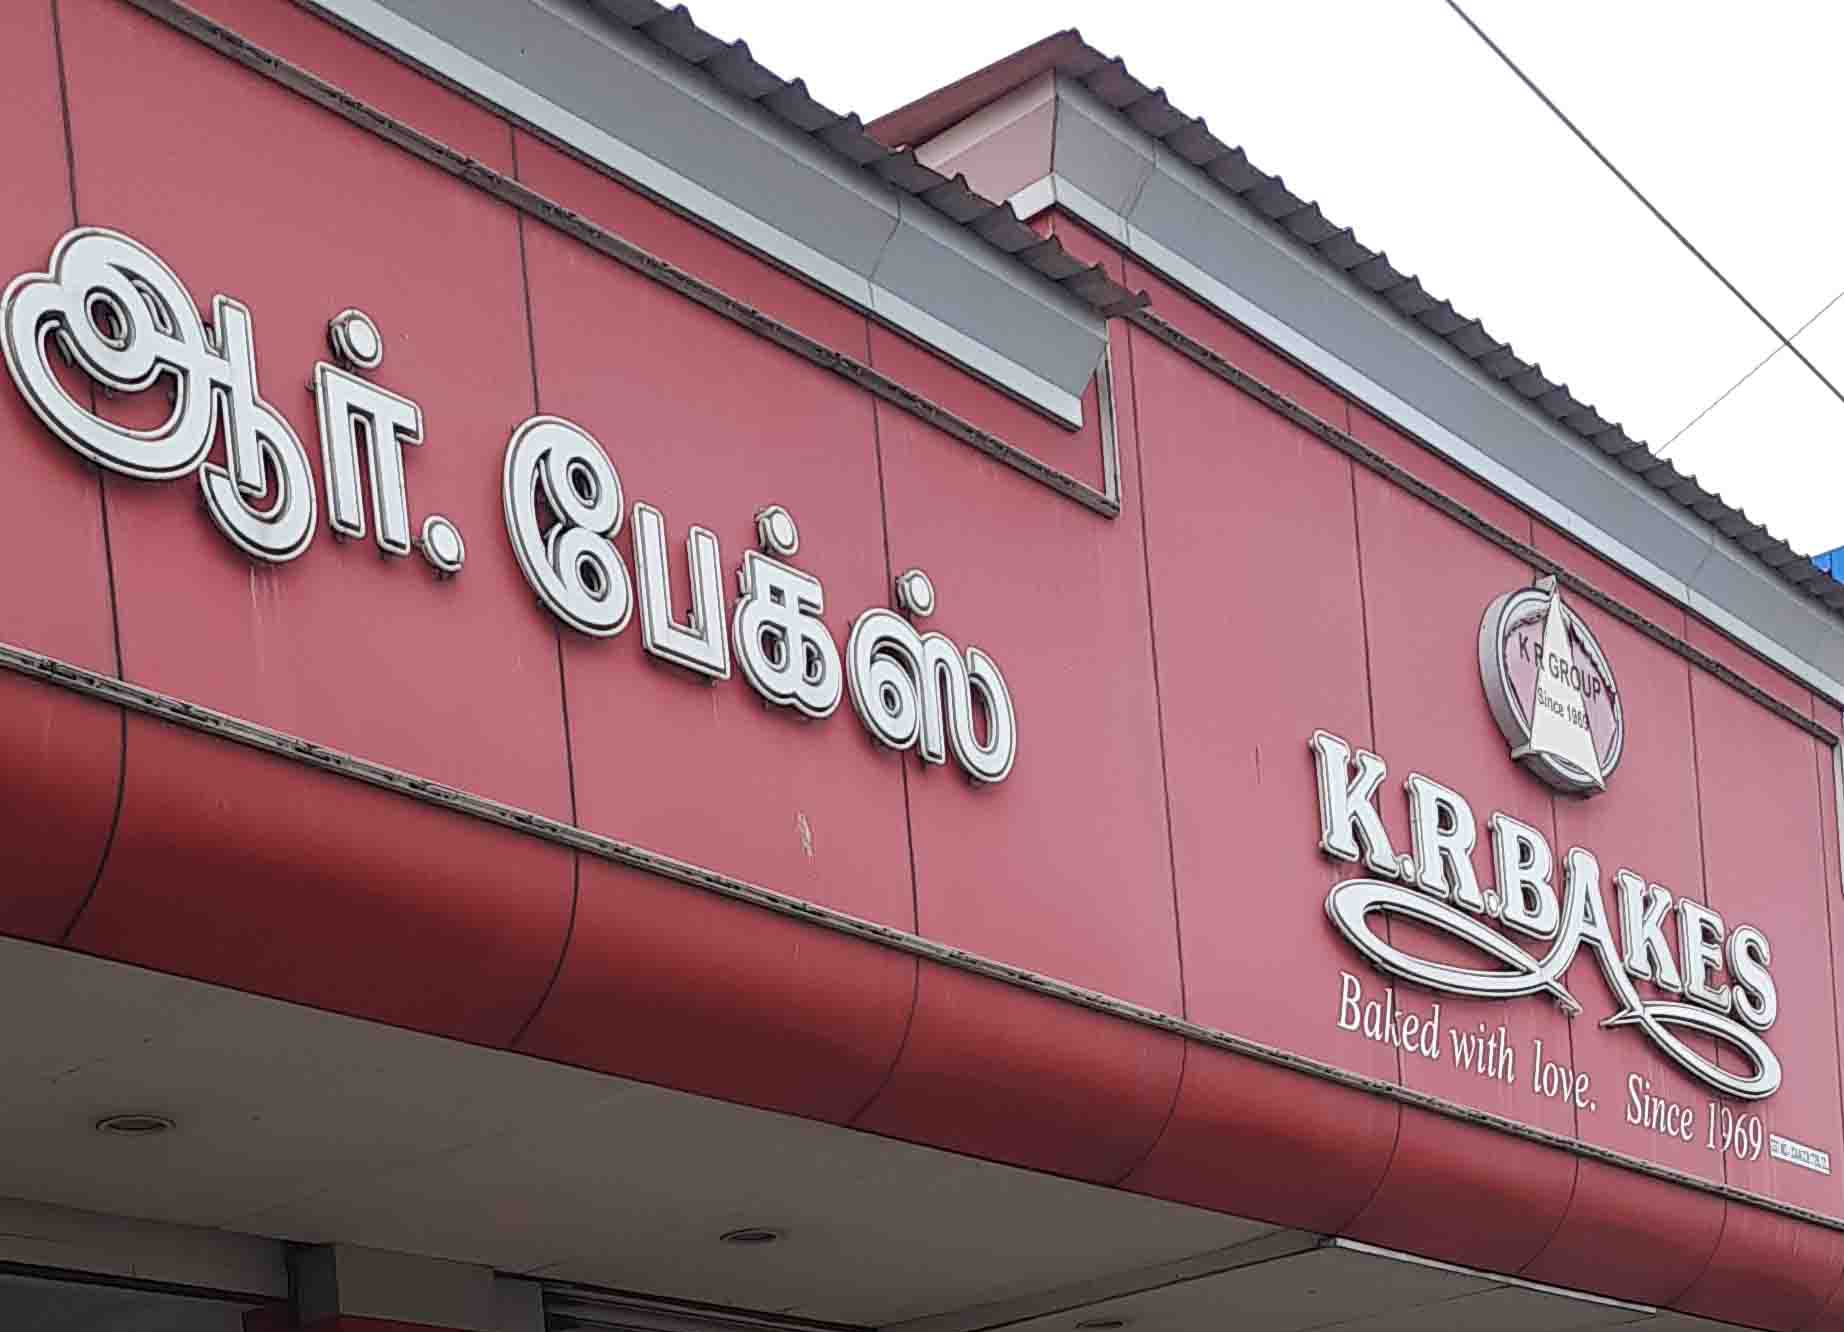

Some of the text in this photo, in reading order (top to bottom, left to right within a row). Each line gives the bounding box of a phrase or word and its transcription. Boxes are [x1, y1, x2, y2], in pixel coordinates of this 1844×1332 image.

[1, 226, 1017, 784] ஆர். பேக்ஸ்
[1518, 632, 1602, 704] K R GROUP
[1537, 687, 1565, 718] Since
[1337, 971, 1441, 1060] Baked
[1449, 1022, 1515, 1084] with
[1533, 1040, 1597, 1112] love.
[1626, 1073, 1695, 1142] Since
[1707, 1102, 1763, 1162] 1969
